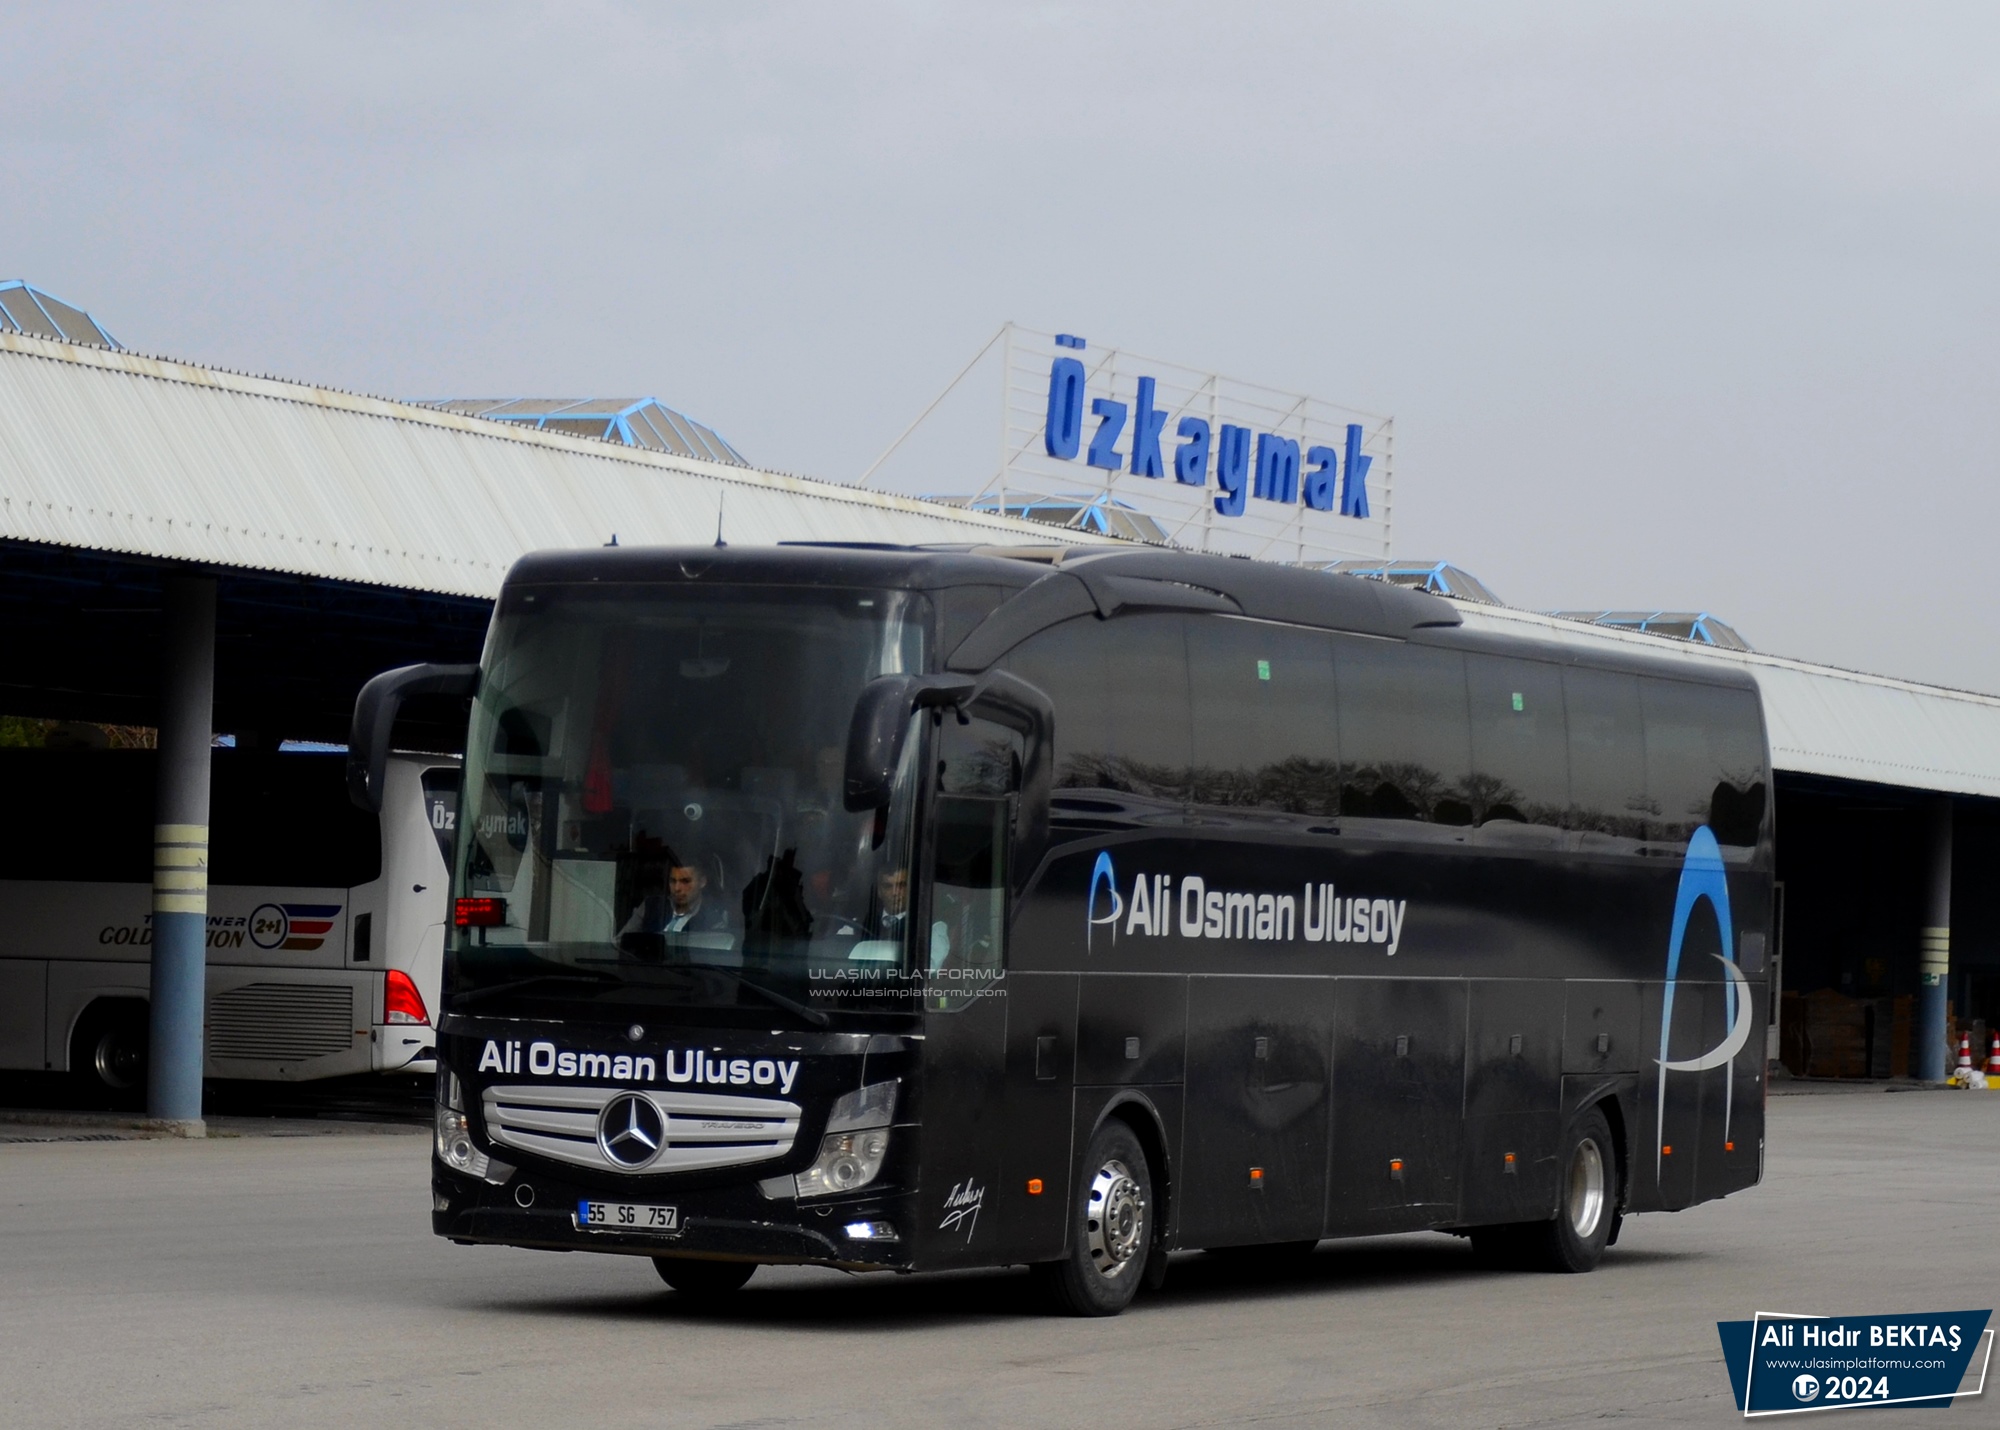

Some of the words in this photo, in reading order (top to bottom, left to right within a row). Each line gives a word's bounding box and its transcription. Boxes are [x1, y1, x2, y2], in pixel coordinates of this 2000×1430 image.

[1045, 334, 1373, 518] Özkaymak
[1126, 873, 1171, 937] Ali
[1180, 876, 1295, 940] Osman
[1304, 883, 1407, 956] Ulusoy
[478, 1041, 520, 1075] Ali
[529, 1042, 656, 1082] Osman
[666, 1049, 800, 1095] Ulusoy
[588, 1204, 605, 1222] 55
[618, 1206, 635, 1224] SG
[648, 1207, 675, 1226] 757
